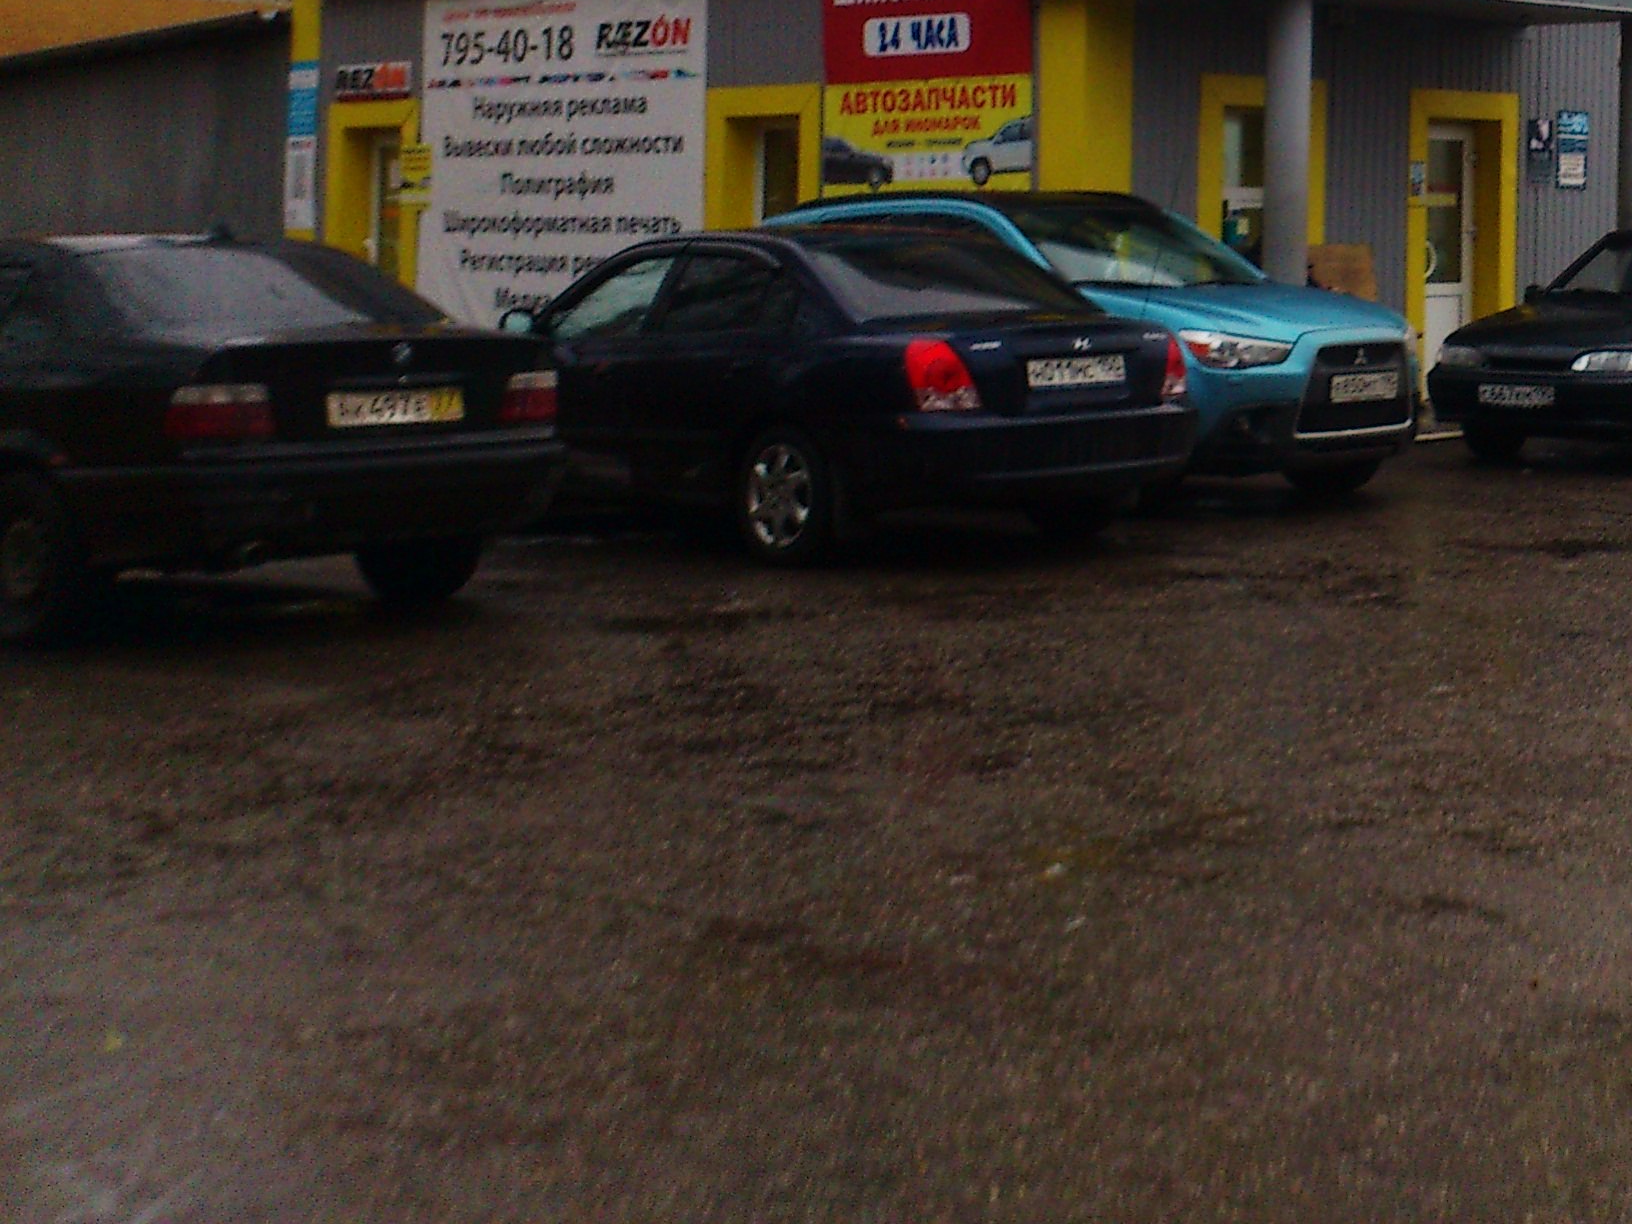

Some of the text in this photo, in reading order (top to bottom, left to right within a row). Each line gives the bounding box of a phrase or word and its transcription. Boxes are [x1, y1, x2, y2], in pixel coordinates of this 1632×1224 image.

[441, 25, 574, 67] 795-40-18
[878, 17, 959, 53] 24 ЧАСА
[840, 84, 1016, 115] АВТОЗАПЧАСТИ
